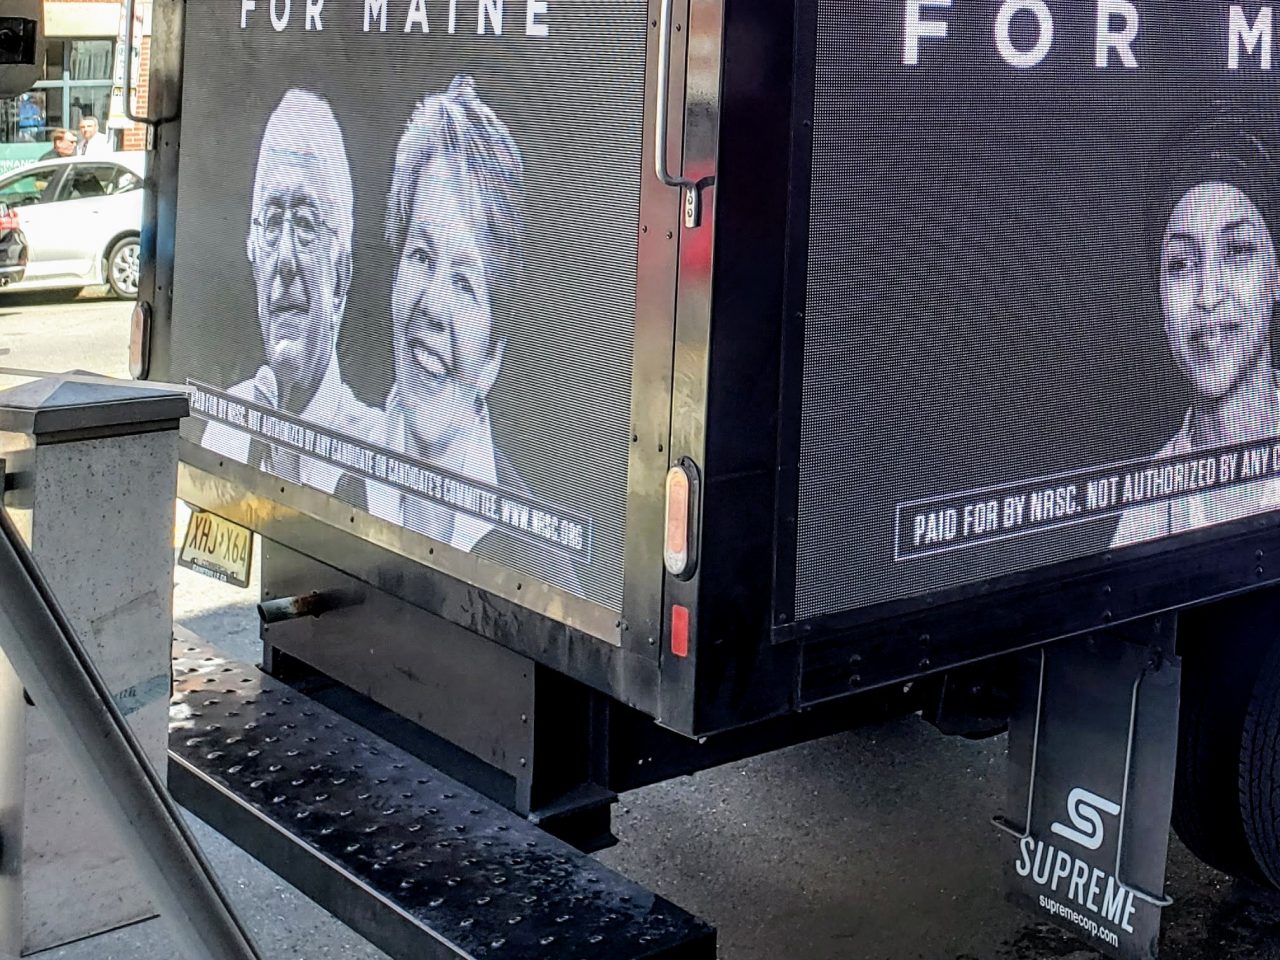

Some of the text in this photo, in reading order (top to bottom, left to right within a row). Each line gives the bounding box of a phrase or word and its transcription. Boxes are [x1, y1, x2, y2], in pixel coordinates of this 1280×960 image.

[262, 414, 304, 448] AUTHORIZED
[305, 428, 315, 452] BY
[315, 433, 331, 458] ANY
[331, 438, 374, 473] CANDIDATE
[387, 458, 442, 498] CANDIDATE'S
[914, 510, 957, 546] PAID
[963, 501, 998, 536] FOR
[1002, 495, 1026, 528] BY
[1030, 484, 1081, 522] NRSC.
[1086, 477, 1120, 510] NOT
[1122, 458, 1217, 502] AUTHORIZED
[1220, 453, 1237, 483] BY
[1240, 443, 1270, 478] ANY
[1015, 836, 1136, 934] SUPREME
[1039, 894, 1119, 948] supremecorp.com
